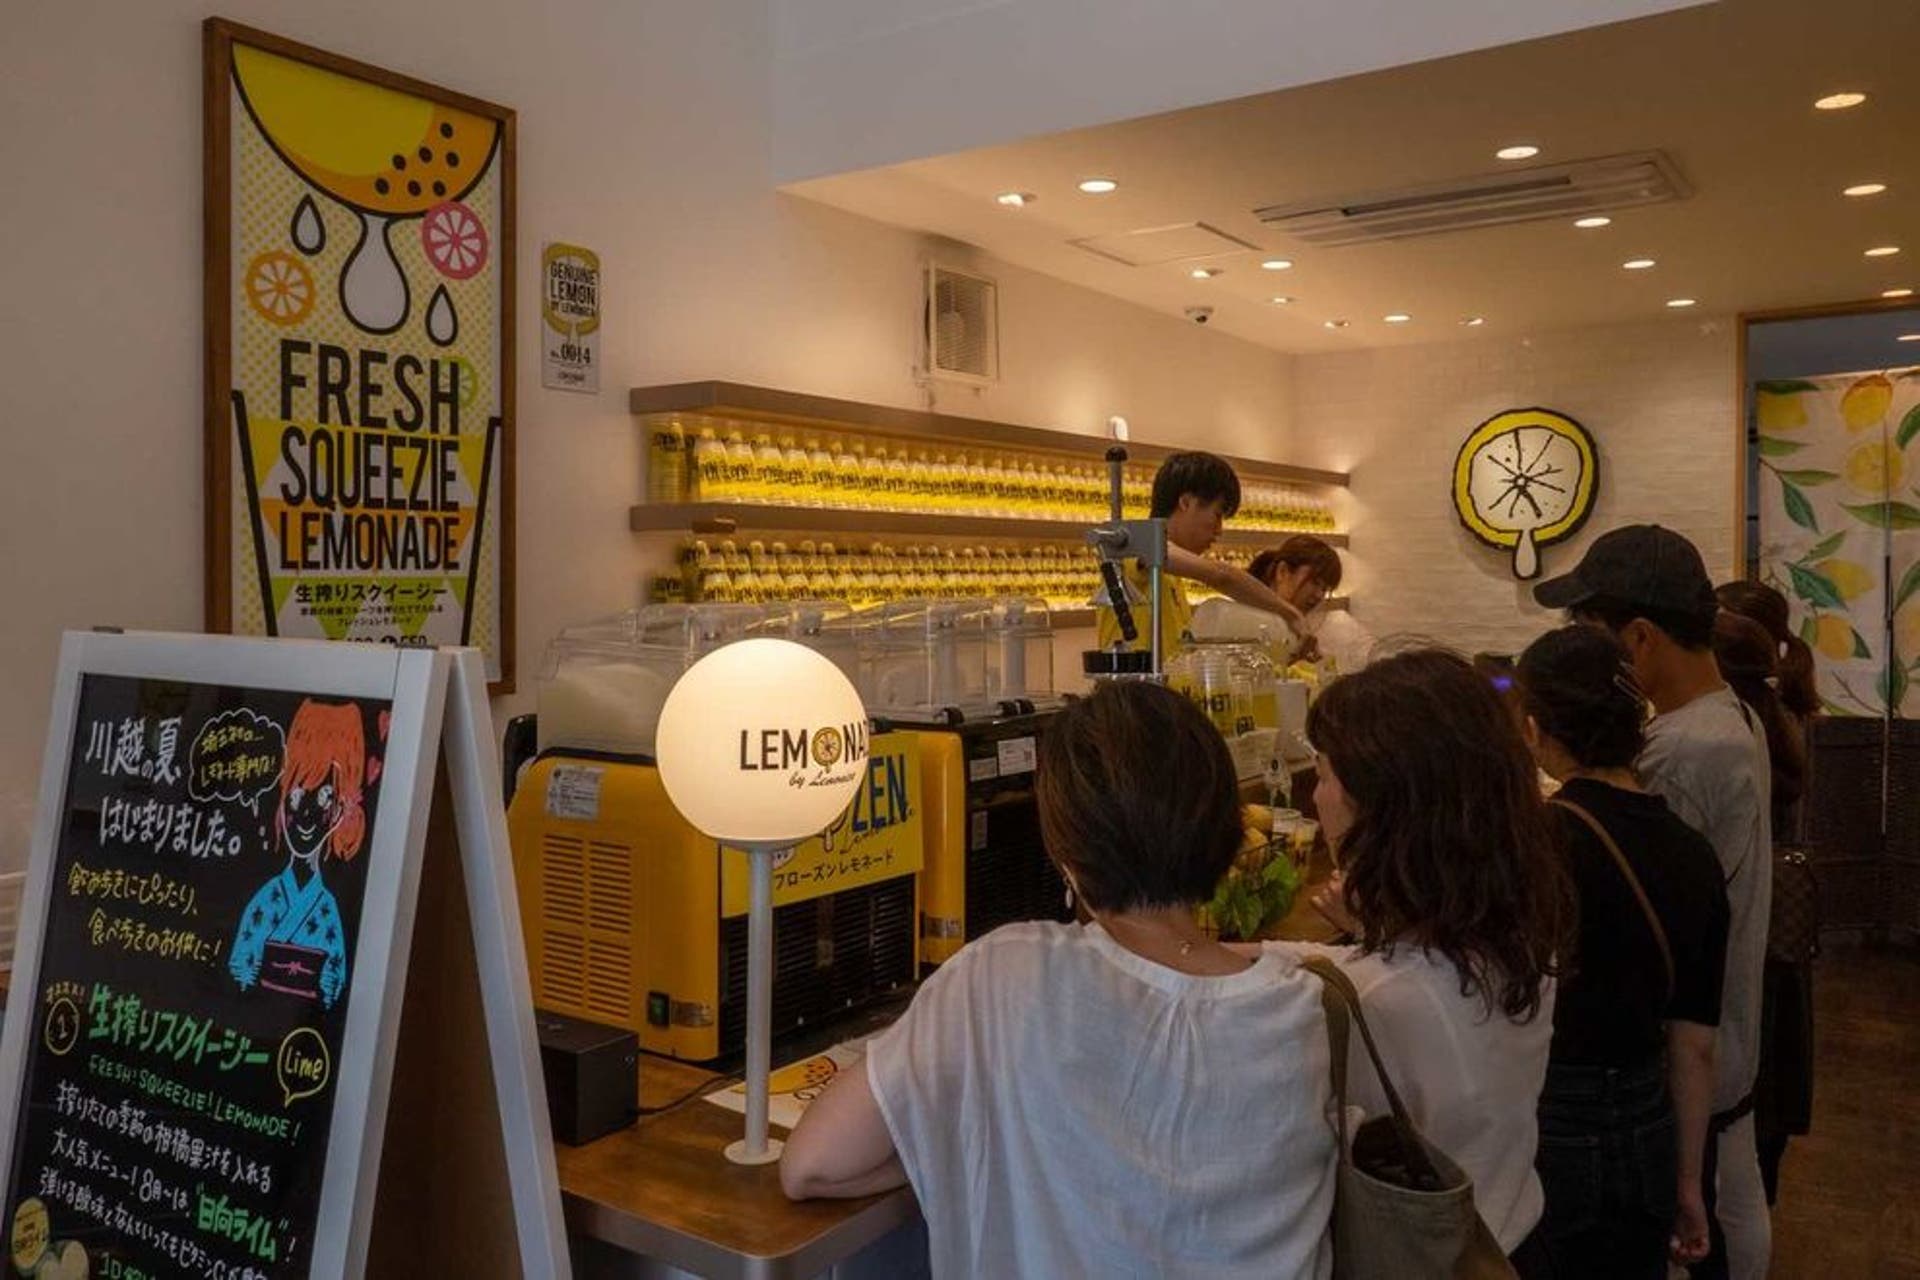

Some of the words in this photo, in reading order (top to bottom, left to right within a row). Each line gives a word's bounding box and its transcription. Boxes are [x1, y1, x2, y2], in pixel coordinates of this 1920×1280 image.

[551, 280, 596, 305] LEMON
[280, 339, 460, 435] FRESH
[280, 426, 460, 512] SQUEEZIE
[280, 512, 460, 570] LEMONADE
[295, 583, 448, 603] 生搾りスクイージー
[100, 796, 242, 859] はじまりました。
[774, 850, 895, 890] フローズンレモネード
[88, 981, 271, 1072] 生搾りスクイージー
[284, 1044, 325, 1081] Lime
